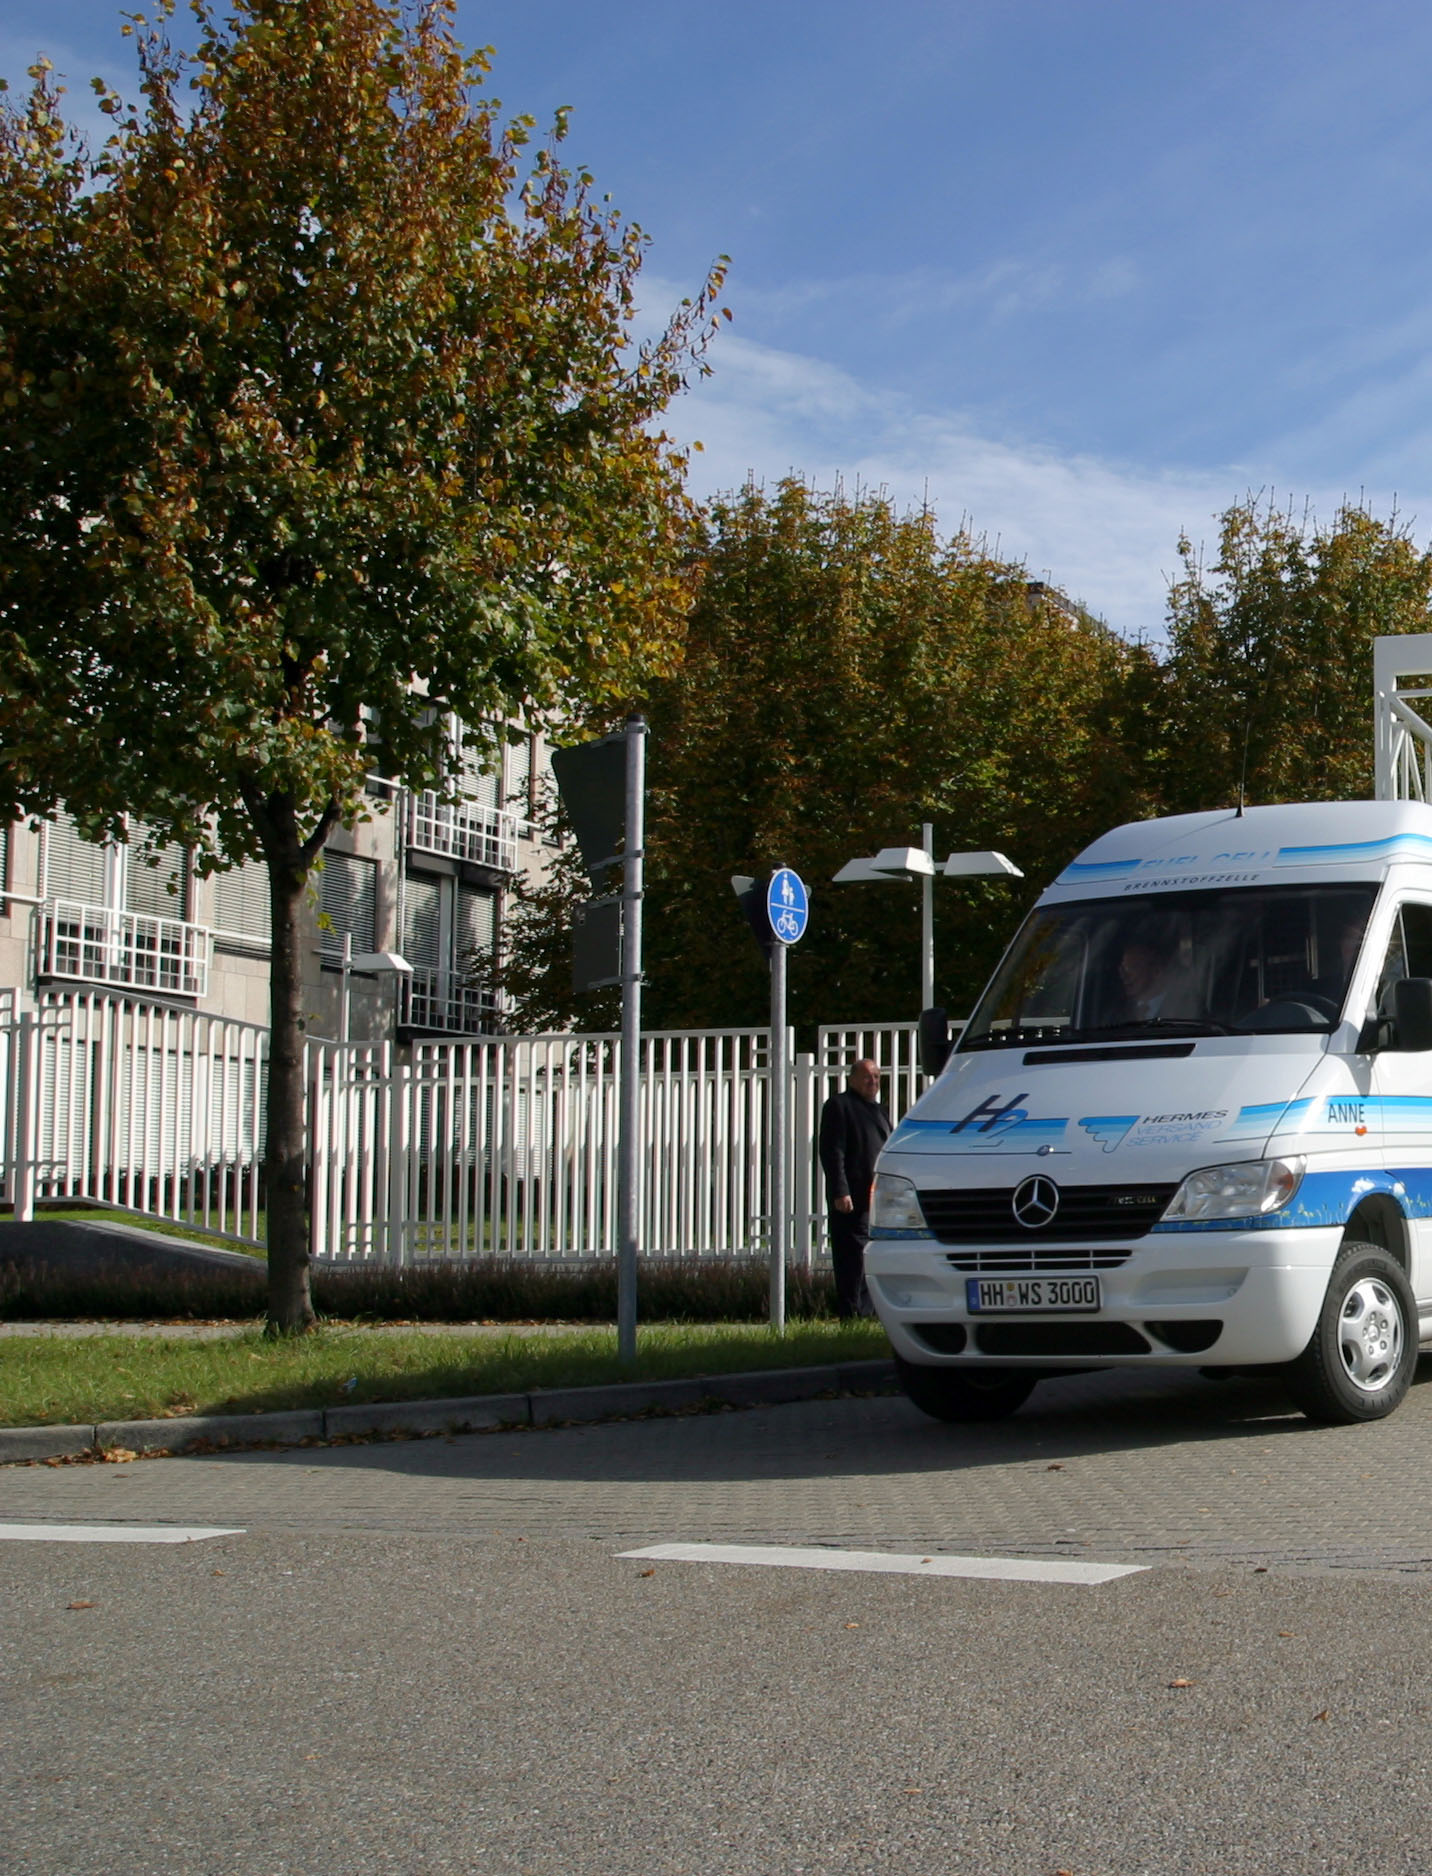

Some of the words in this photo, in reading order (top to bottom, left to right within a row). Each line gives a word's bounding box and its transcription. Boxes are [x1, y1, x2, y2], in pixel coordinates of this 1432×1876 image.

[1123, 873, 1260, 891] BRENNSTOFFZELLE
[1142, 1109, 1229, 1125] HERMES
[1327, 1103, 1365, 1124] ANNE
[1136, 1119, 1222, 1135] VERSAND
[1126, 1131, 1203, 1147] SERVICE
[980, 1282, 1004, 1306] HH
[1017, 1282, 1042, 1305] WS
[1047, 1281, 1095, 1304] 3000
